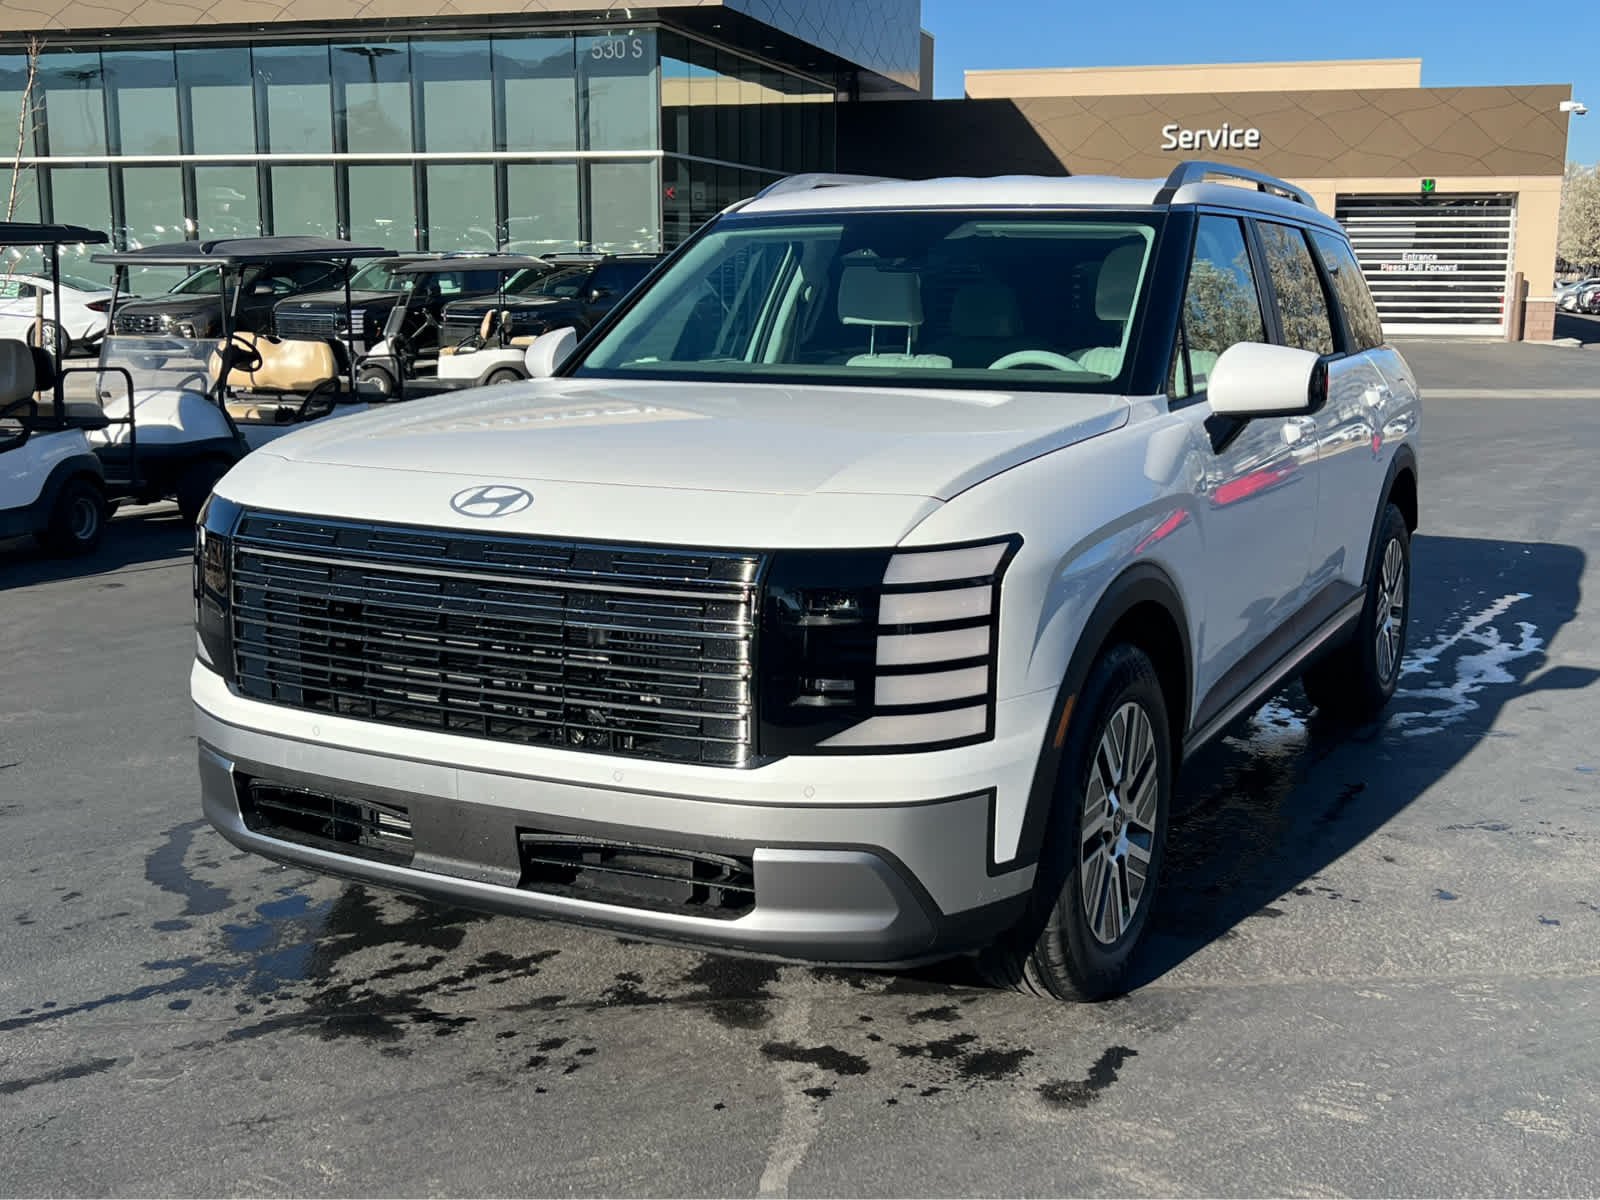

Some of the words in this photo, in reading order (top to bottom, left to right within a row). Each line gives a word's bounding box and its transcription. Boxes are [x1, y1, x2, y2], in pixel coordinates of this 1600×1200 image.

[592, 39, 626, 59] 530
[632, 38, 643, 58] S
[1161, 123, 1260, 150] Service
[1402, 252, 1438, 261] Entrance
[1381, 263, 1406, 272] Please
[1408, 263, 1423, 272] Pull
[1425, 263, 1458, 272] Forward
